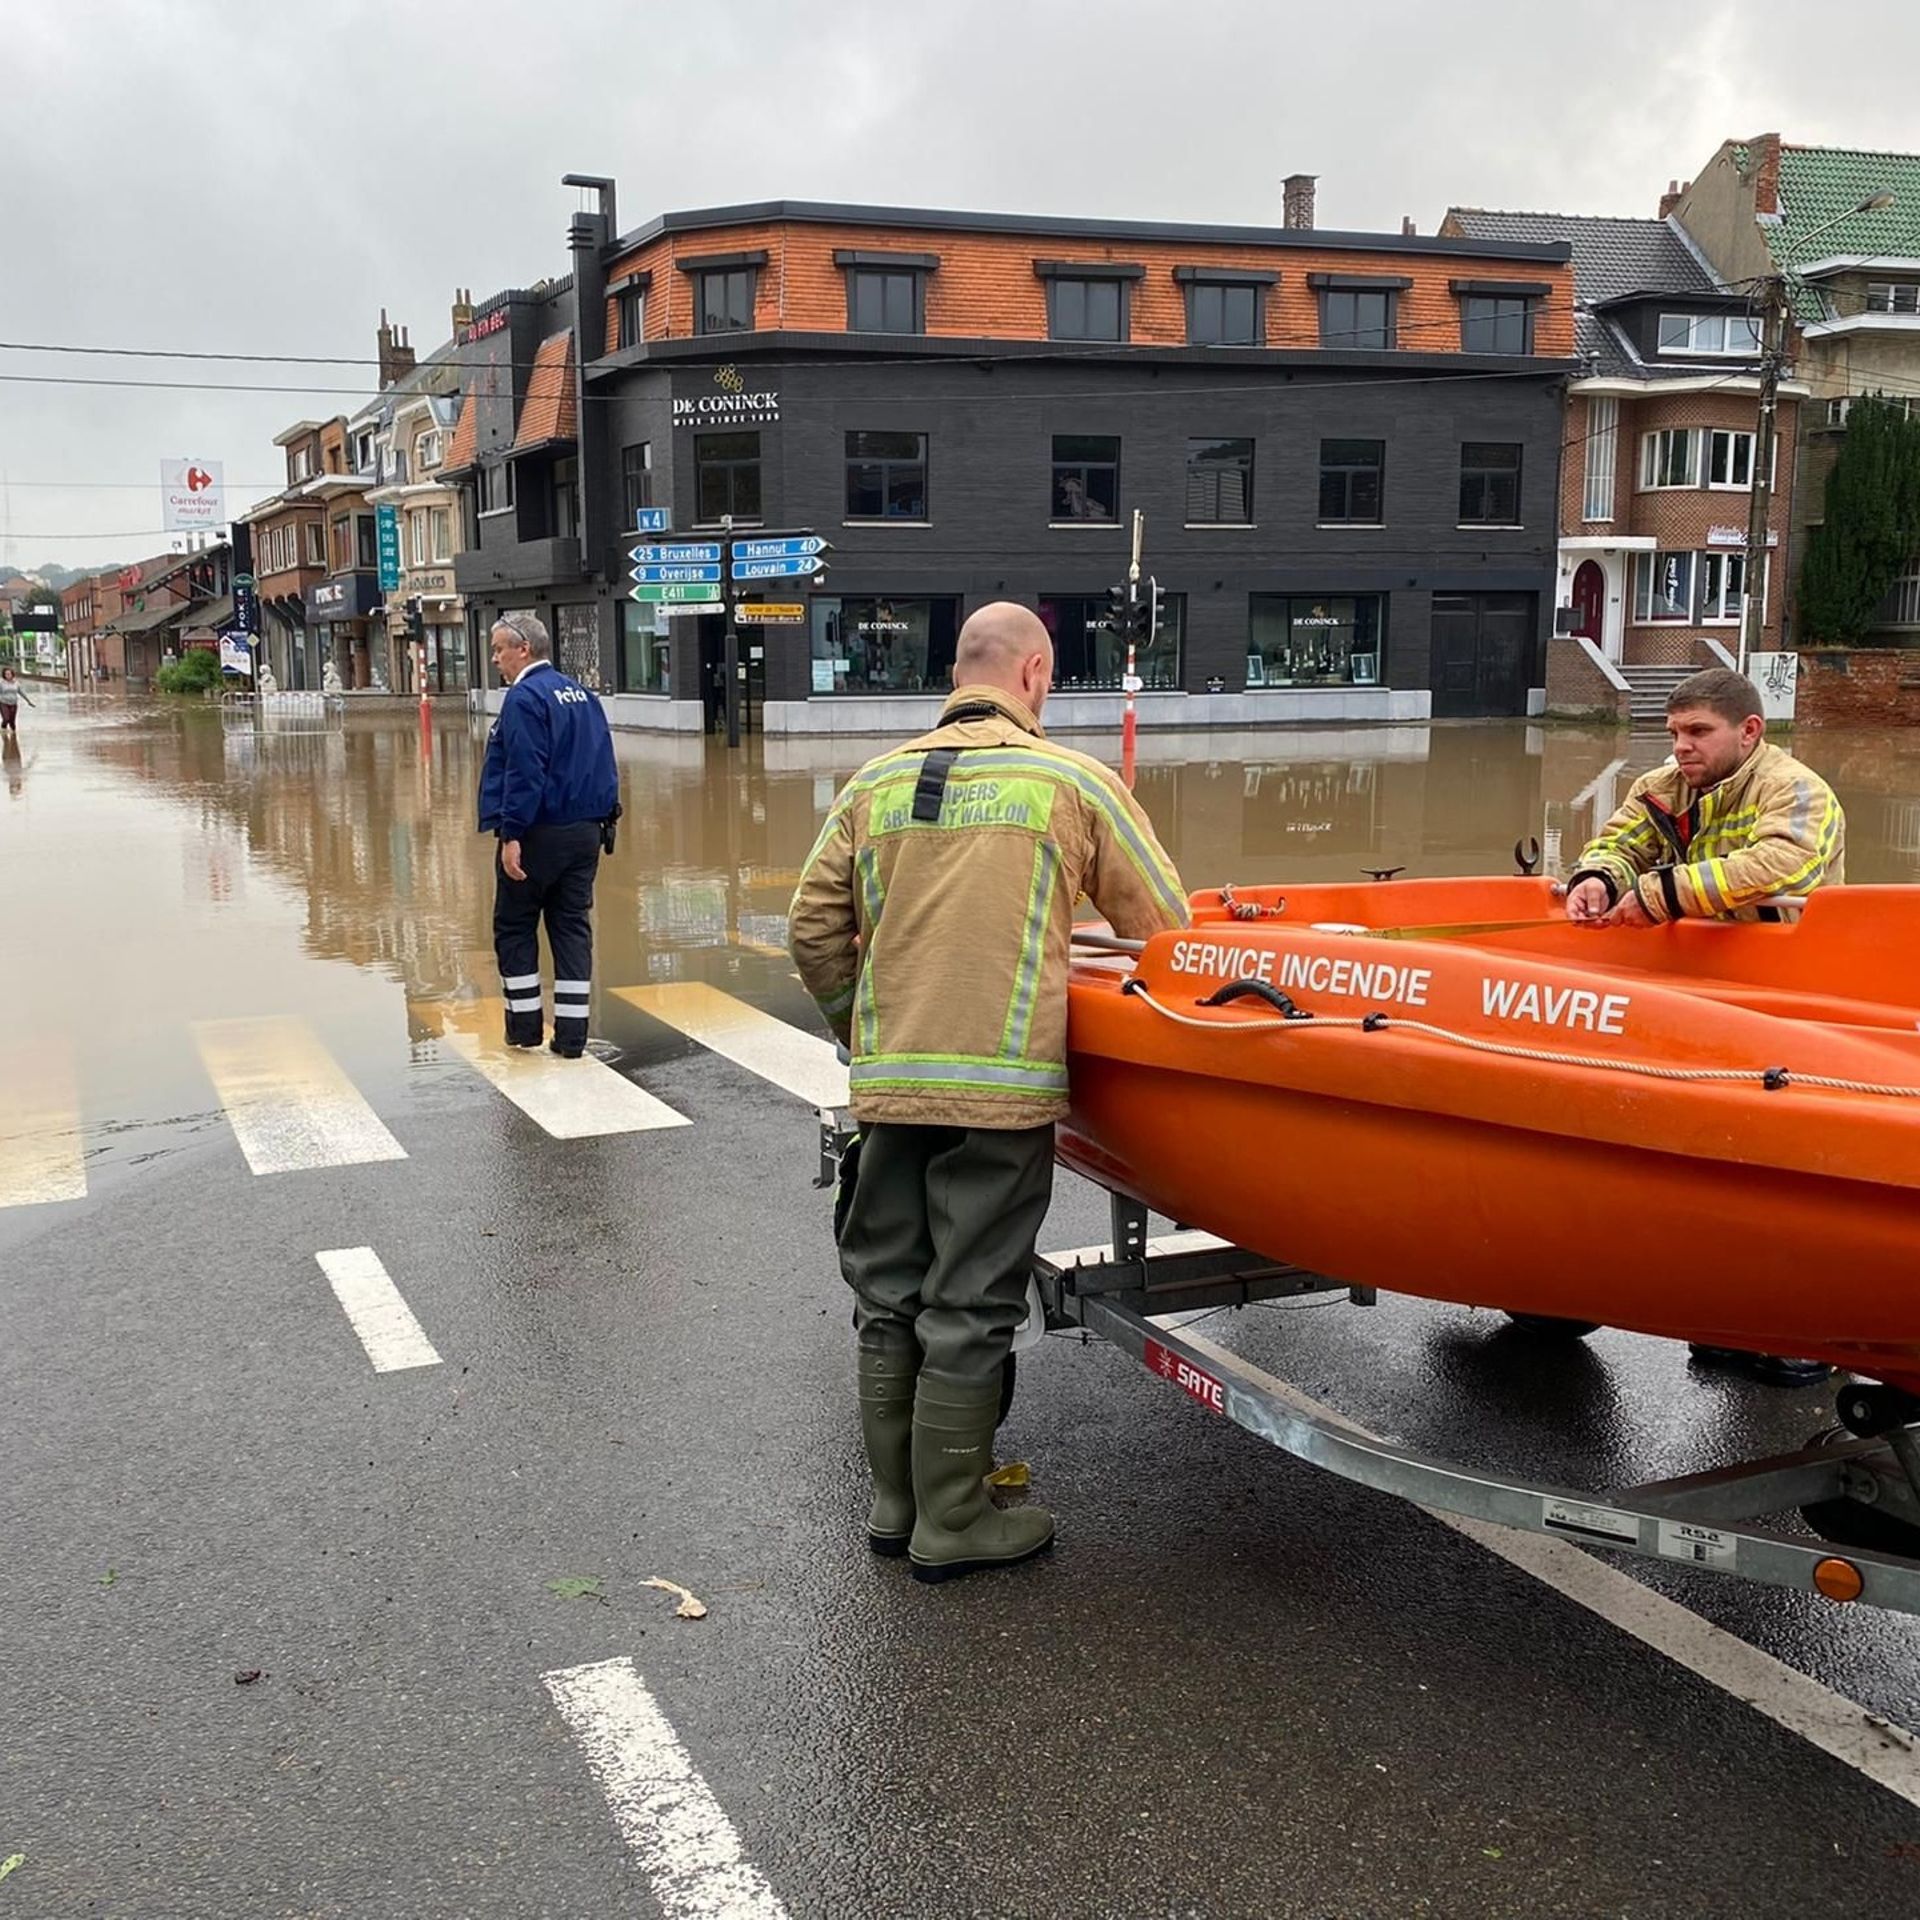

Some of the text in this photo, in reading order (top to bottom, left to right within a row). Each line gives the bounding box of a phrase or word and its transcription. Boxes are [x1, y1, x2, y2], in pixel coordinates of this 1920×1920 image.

[673, 392, 779, 414] DE CONINCK
[169, 495, 218, 506] Carrefour
[642, 511, 661, 528] N 4
[638, 547, 711, 560] 25 Bruxelles
[746, 540, 816, 556] Hannut 40
[638, 567, 704, 581] 9 Overijse
[745, 560, 812, 576] Louvain 24
[661, 587, 685, 599] E411
[858, 622, 908, 630] DE CONINCK
[1086, 620, 1096, 628] DE
[1293, 617, 1340, 626] DE CONINCK
[961, 804, 1031, 825] WALLON
[1169, 940, 1630, 1034] SERVICE INCENDIE WAVRE
[1177, 1362, 1224, 1409] SATE
